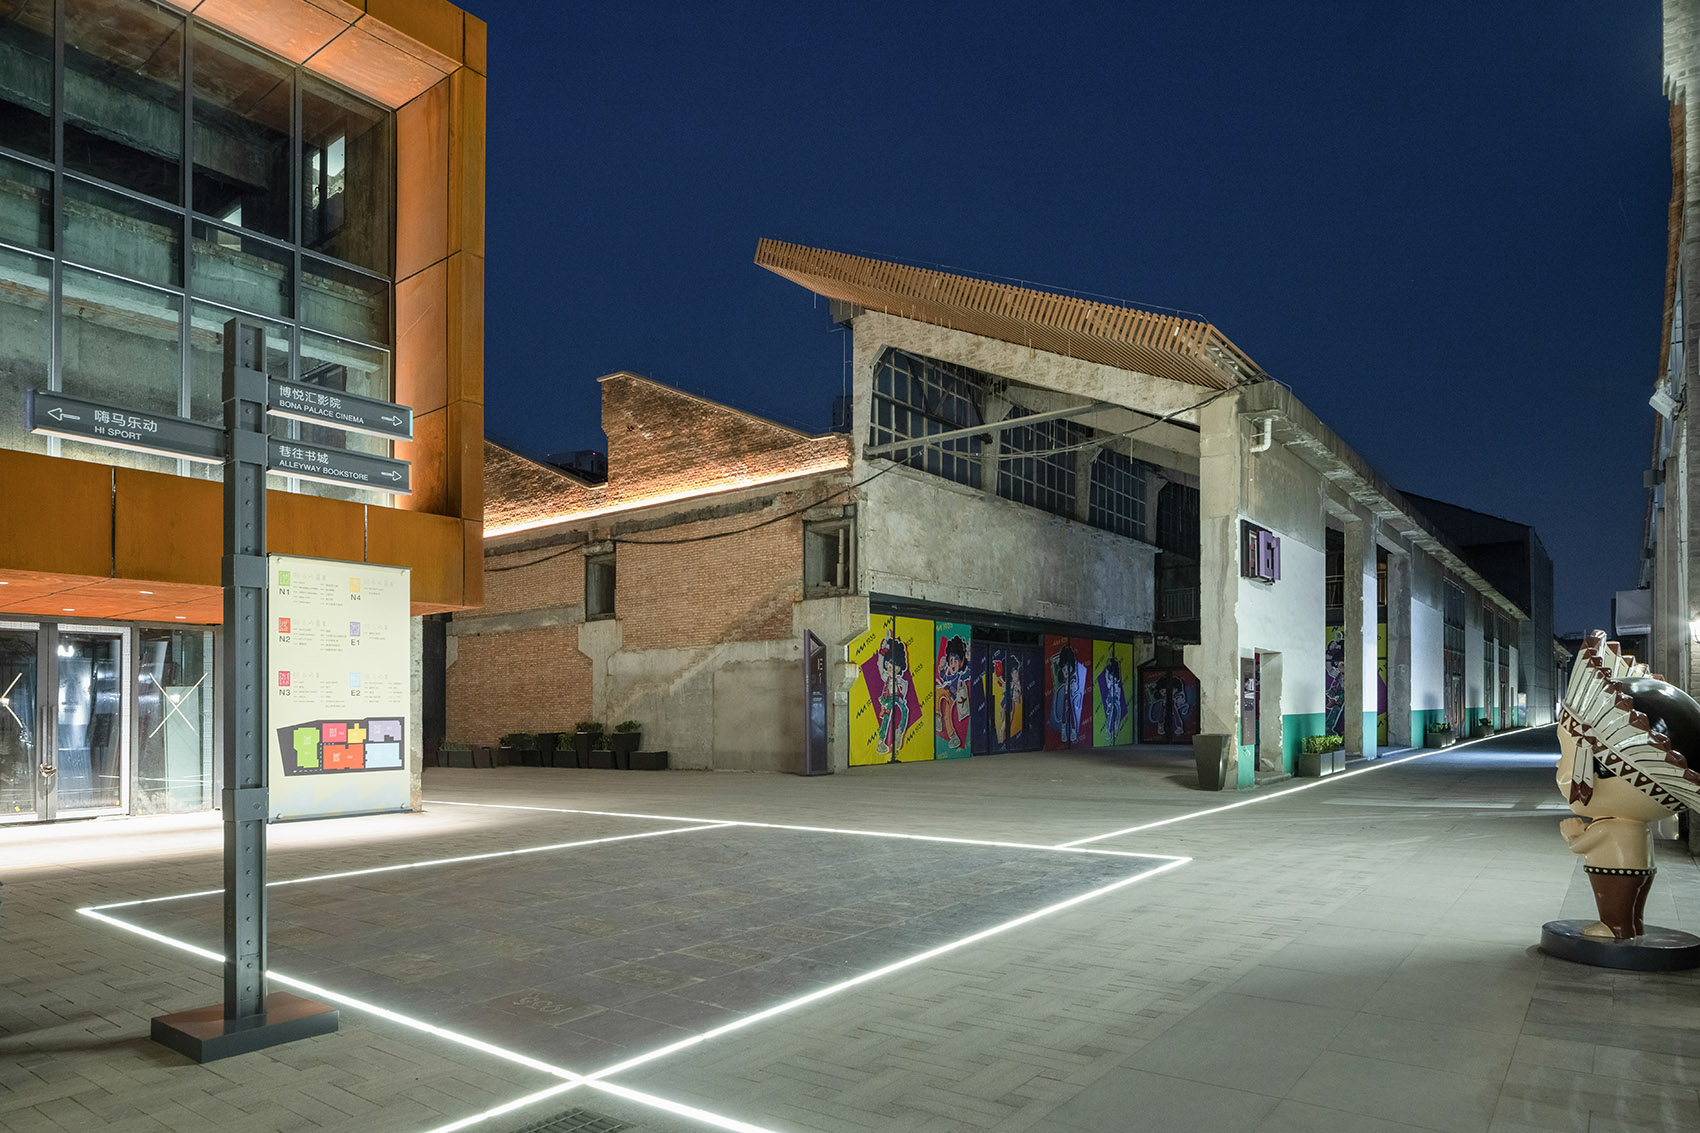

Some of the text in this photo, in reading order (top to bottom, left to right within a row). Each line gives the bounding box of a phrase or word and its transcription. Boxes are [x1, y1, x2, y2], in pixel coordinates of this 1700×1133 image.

[280, 385, 342, 410] 博悦汇影院
[94, 410, 158, 433] 嗨马乐动
[280, 399, 365, 424] BONA PALACE CINEMA
[94, 426, 142, 440] HI SPORT
[279, 445, 329, 465] 巷往书城
[279, 459, 369, 481] ALLEYWAY BOOKSTORE
[279, 588, 290, 596] N1
